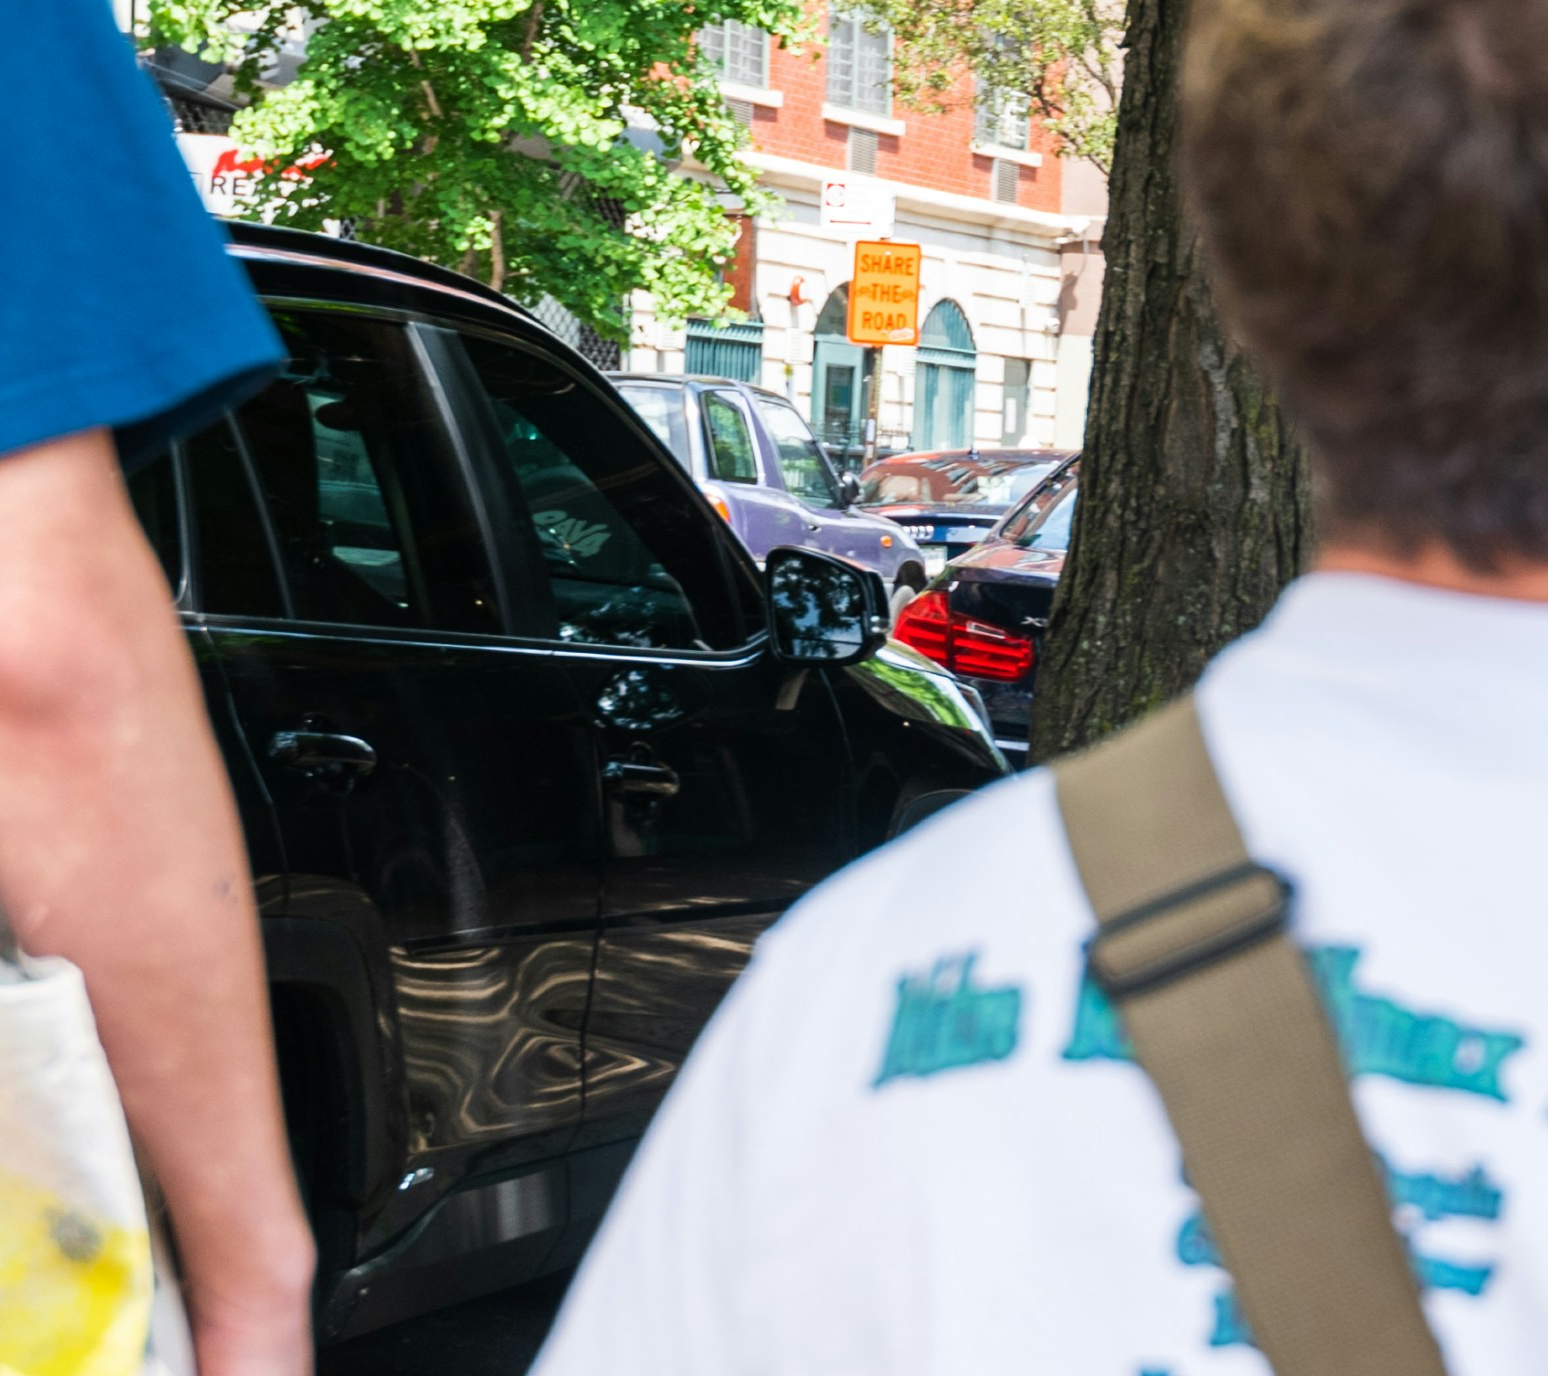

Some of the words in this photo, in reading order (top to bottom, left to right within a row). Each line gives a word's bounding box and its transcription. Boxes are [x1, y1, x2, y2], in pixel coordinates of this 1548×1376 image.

[860, 254, 915, 276] SHARE
[872, 283, 903, 304] THE
[862, 311, 907, 331] ROAD
